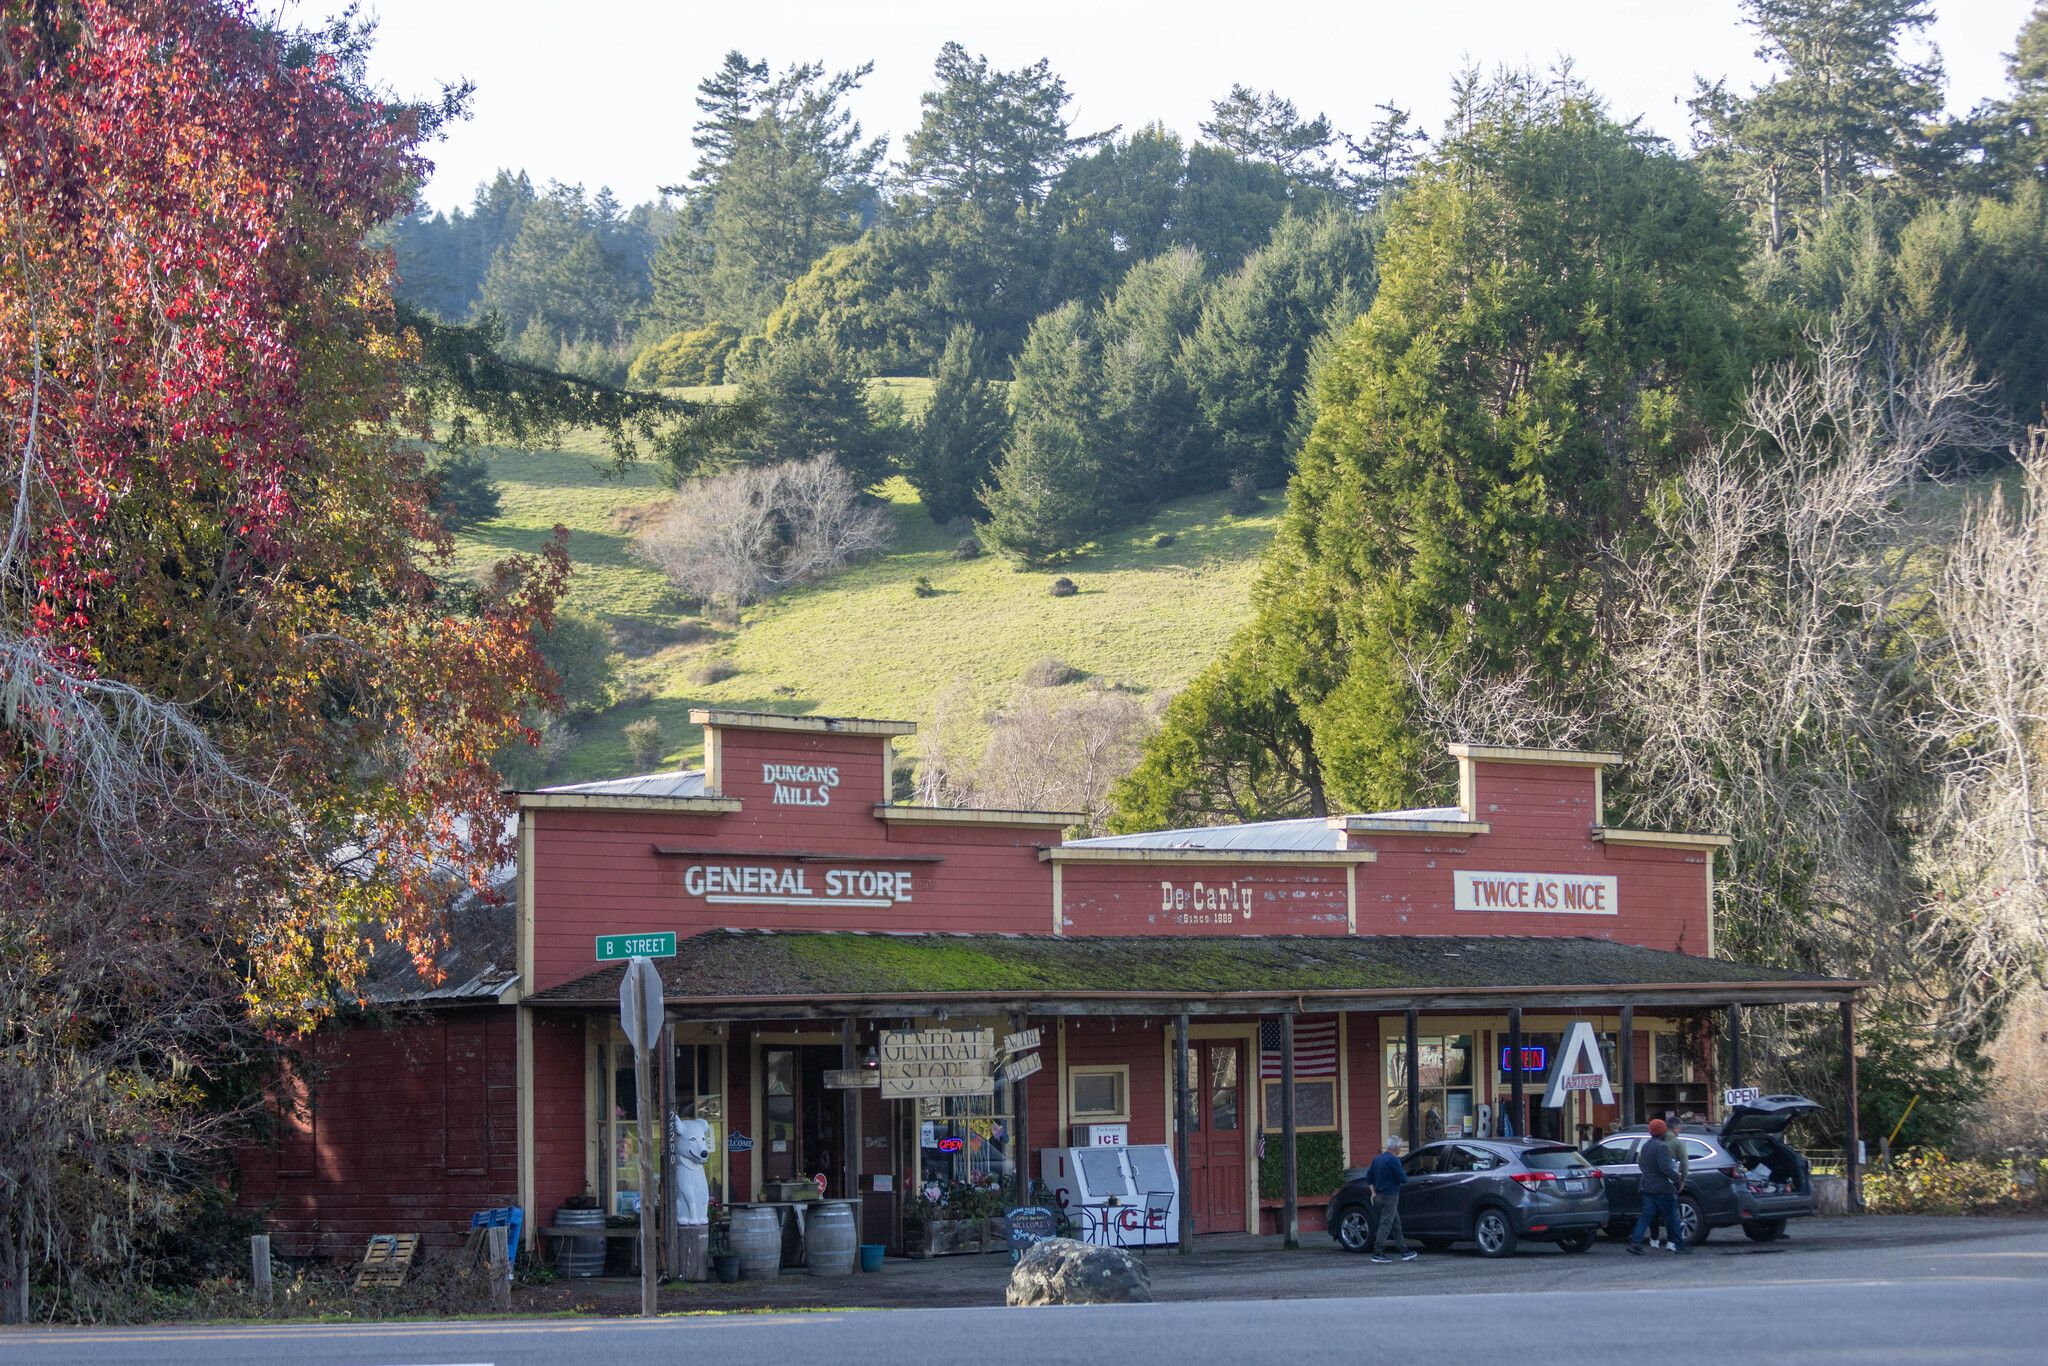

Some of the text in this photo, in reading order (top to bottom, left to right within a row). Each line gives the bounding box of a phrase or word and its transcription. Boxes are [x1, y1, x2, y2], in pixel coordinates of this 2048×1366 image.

[772, 782, 830, 807] MILLS
[685, 866, 912, 902] GENERAL STORE
[1162, 880, 1252, 919] De Carly
[1470, 879, 1605, 911] TWICE AS NICE
[1183, 913, 1232, 923] Since 1888
[606, 938, 666, 955] B STREET
[884, 1031, 981, 1061] GENERAL
[1010, 1030, 1040, 1048] WINE
[902, 1062, 969, 1091] STORE
[1564, 1074, 1604, 1089] ANTIQUES
[1727, 1089, 1757, 1106] OPEN
[728, 1139, 753, 1148] LCOME
[939, 1140, 963, 1150] OPEN
[1098, 1135, 1120, 1145] ICE
